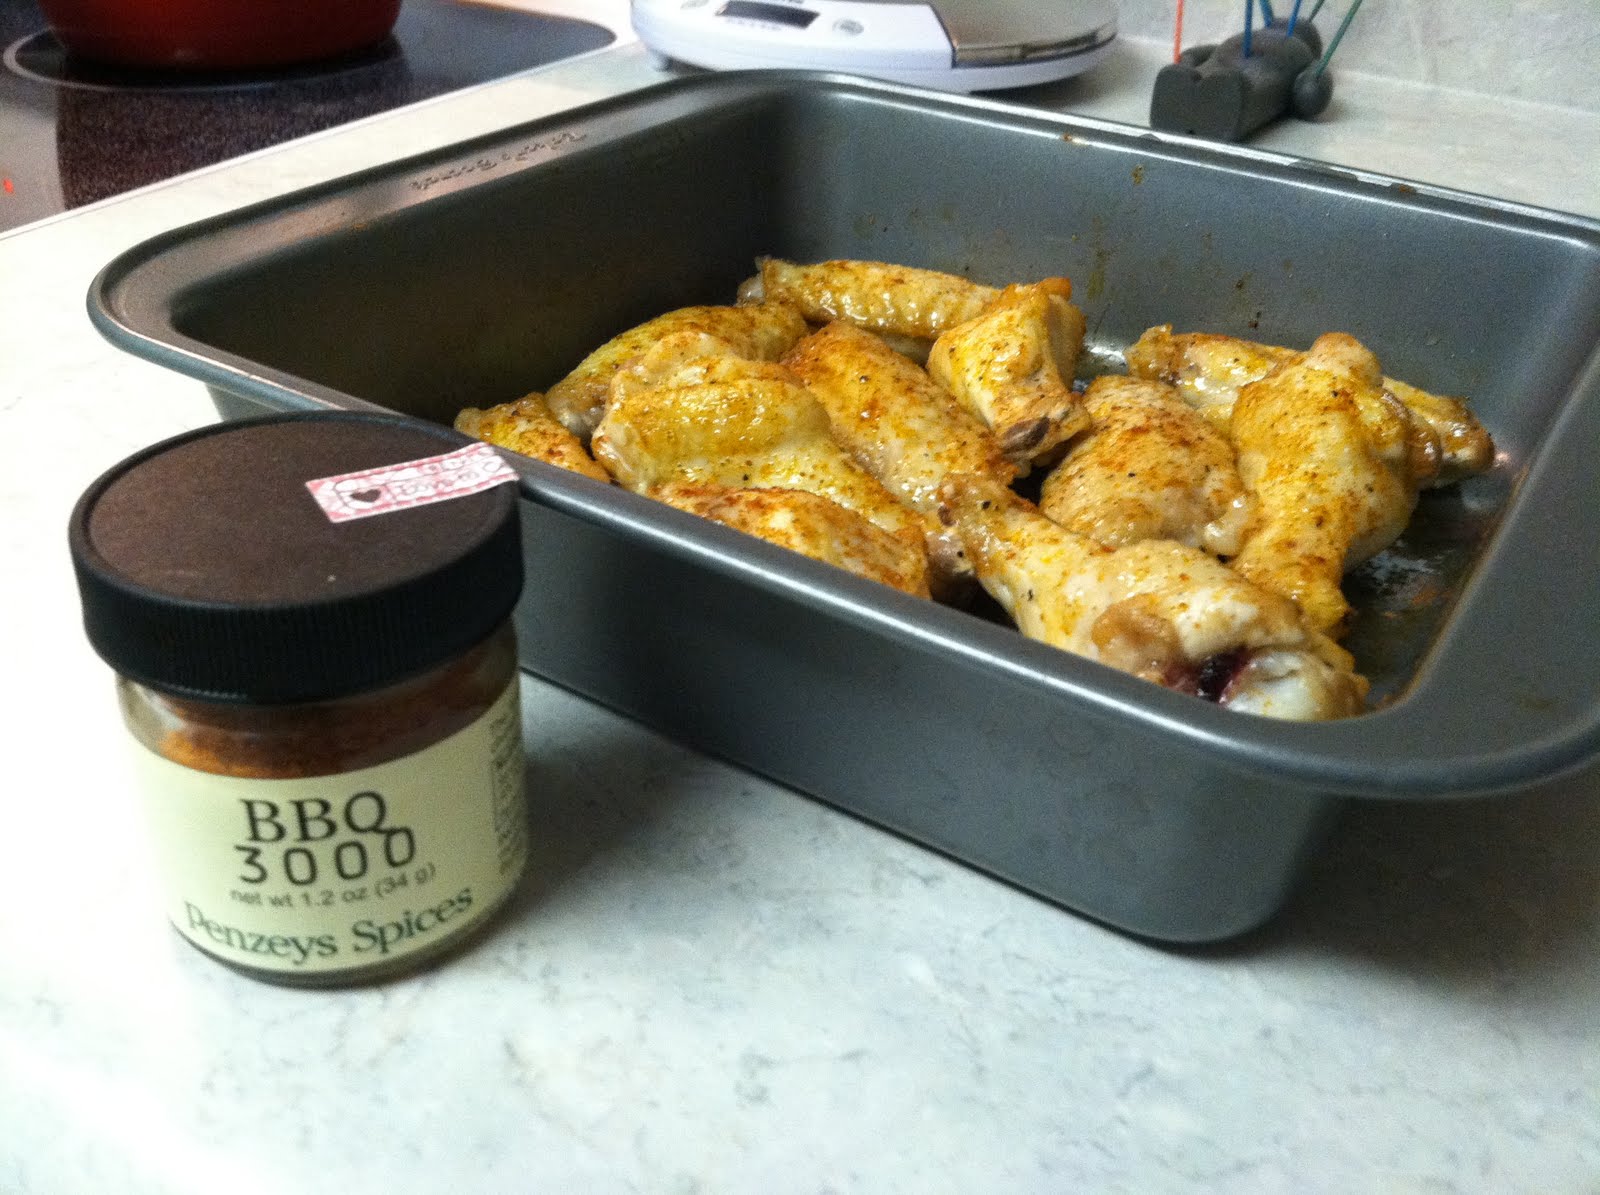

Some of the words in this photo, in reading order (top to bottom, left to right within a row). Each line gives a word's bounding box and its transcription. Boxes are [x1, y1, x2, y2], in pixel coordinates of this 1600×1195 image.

[237, 791, 393, 842] BBQ
[233, 826, 415, 886] 3000
[230, 889, 262, 905] net
[268, 893, 293, 907] wt
[301, 890, 335, 906] 1.2
[342, 887, 367, 902] oz
[184, 899, 338, 966] Penzeys
[352, 887, 473, 954] Spices
